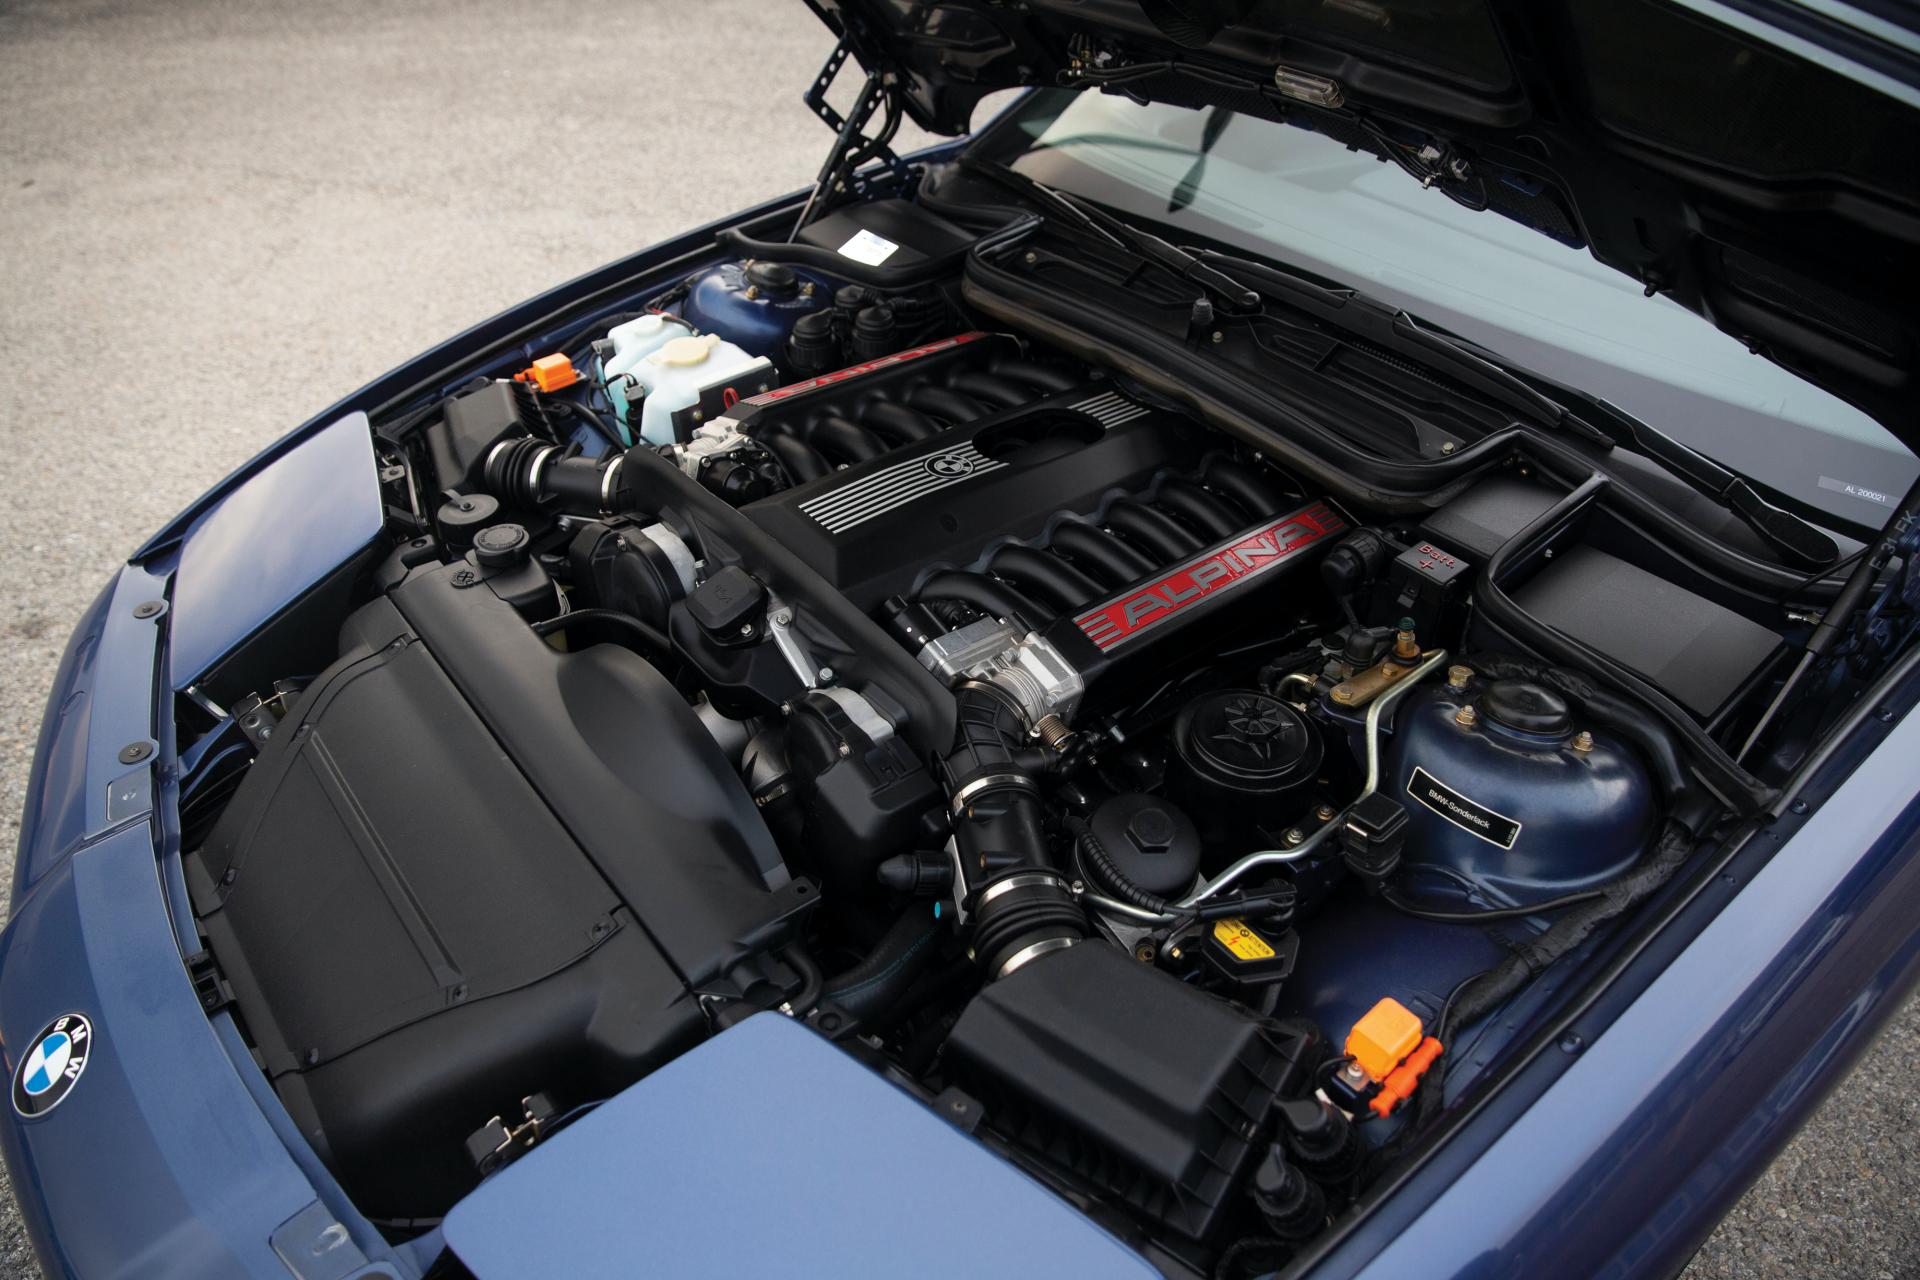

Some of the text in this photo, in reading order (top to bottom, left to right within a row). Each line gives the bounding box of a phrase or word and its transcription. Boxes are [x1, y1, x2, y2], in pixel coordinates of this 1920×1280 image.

[1844, 485, 1886, 503] AL 200021
[1122, 521, 1317, 628] ALPINA
[1868, 556, 1888, 571] E
[1881, 537, 1898, 554] 31
[1428, 788, 1491, 829] BMW-Sonderlack
[53, 1017, 87, 1080] BMW
